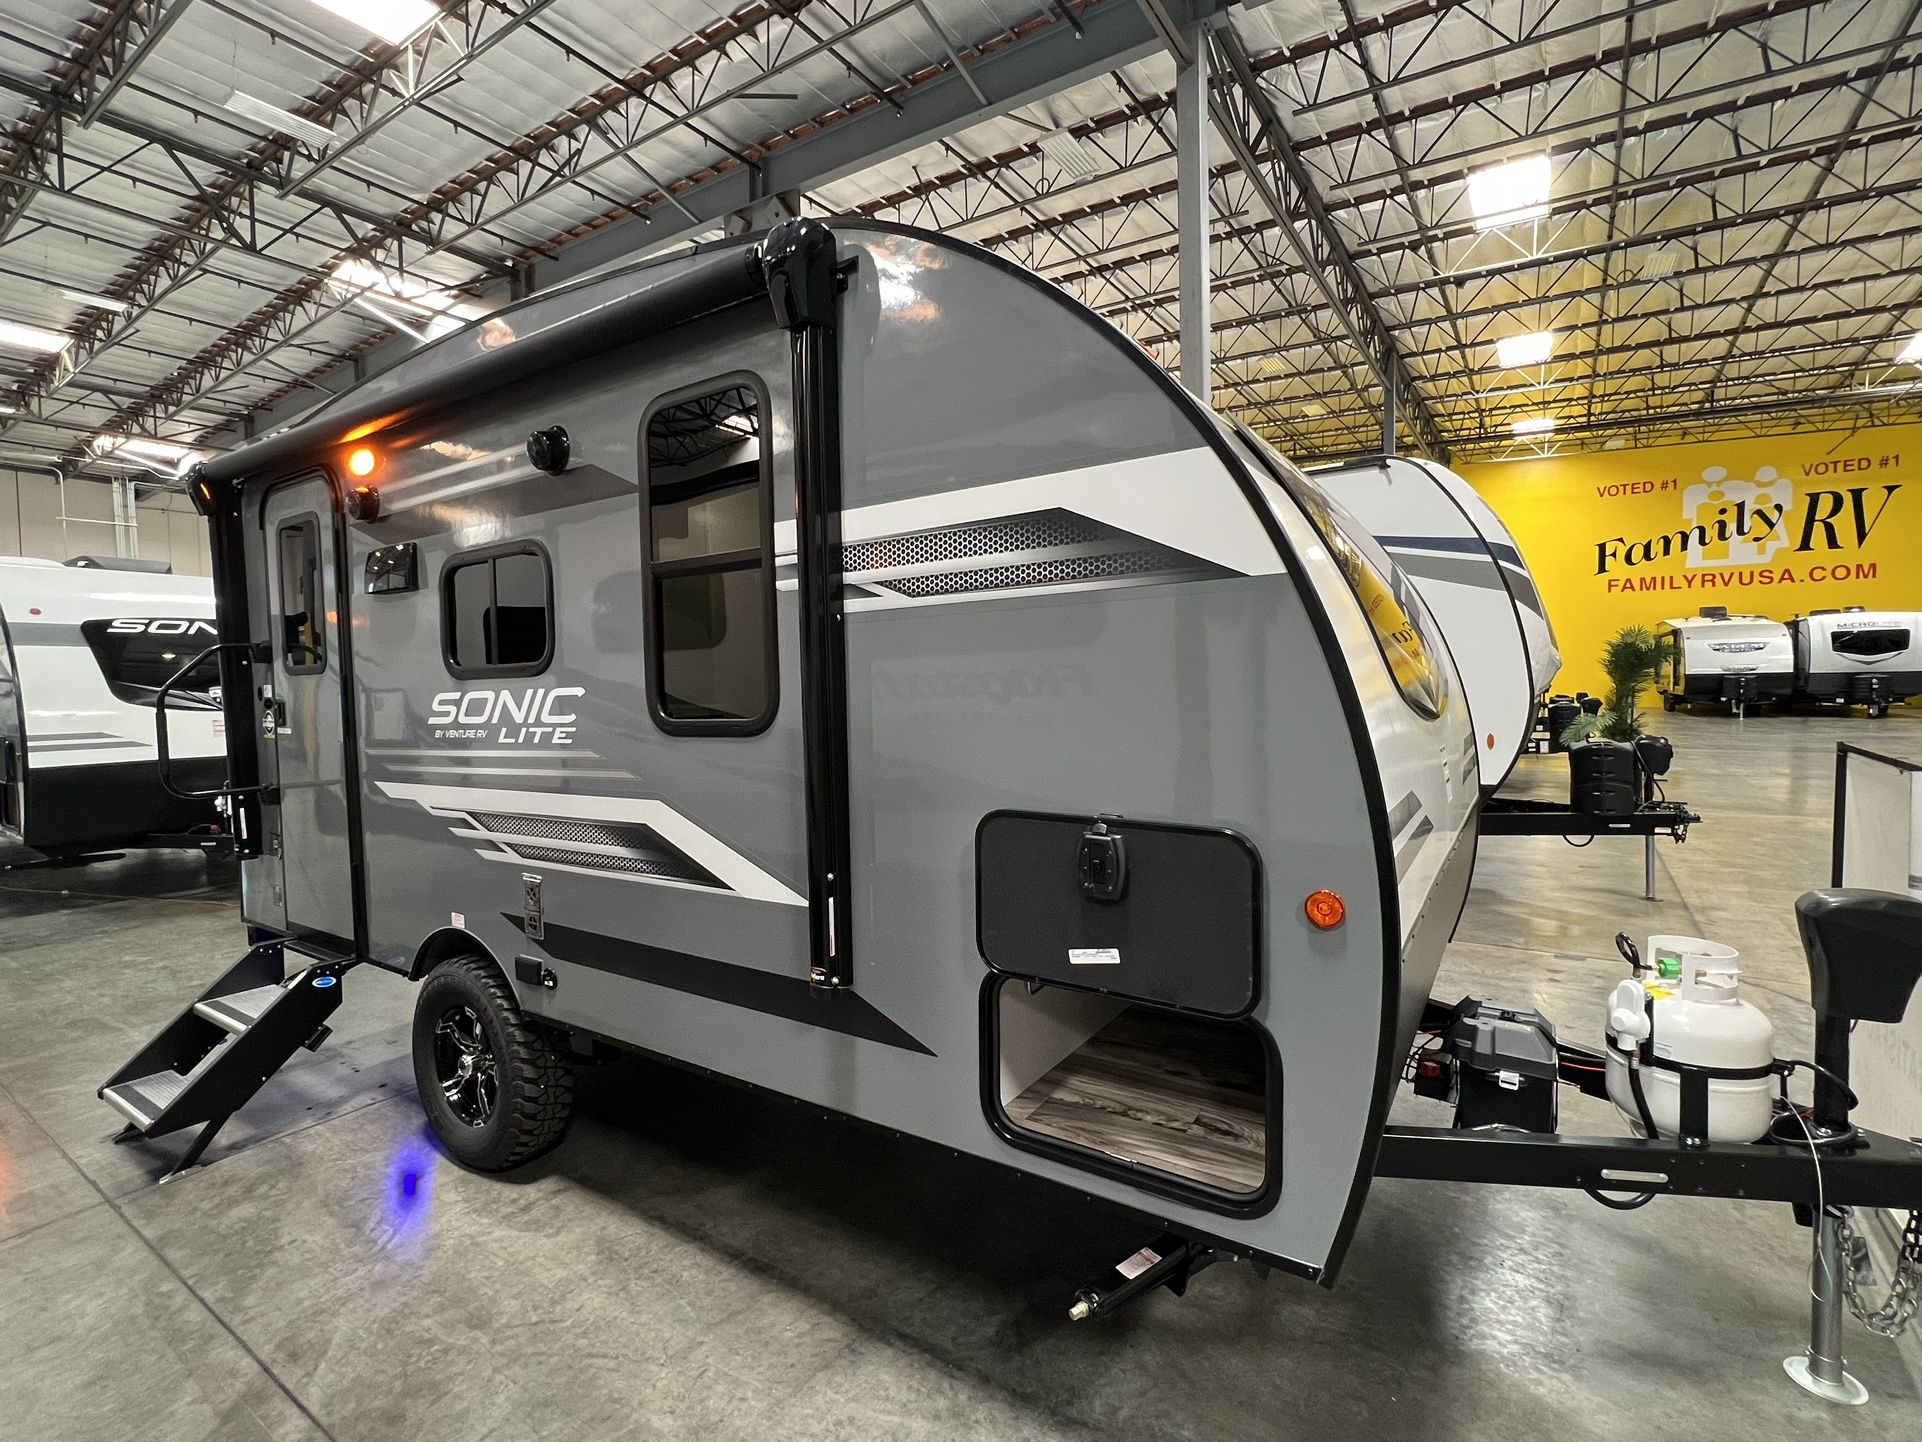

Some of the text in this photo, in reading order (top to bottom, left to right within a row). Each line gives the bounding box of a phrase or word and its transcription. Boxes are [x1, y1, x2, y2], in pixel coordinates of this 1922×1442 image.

[1802, 453, 1901, 477] VOTED #1
[1597, 478, 1679, 498] VOTED #1
[1593, 484, 1903, 576] Family RV
[1607, 562, 1878, 593] FAMILYRVUSA.COM
[427, 686, 586, 725] SONIC
[435, 729, 488, 739] BY VENTURE RV
[498, 727, 577, 744] LITE
